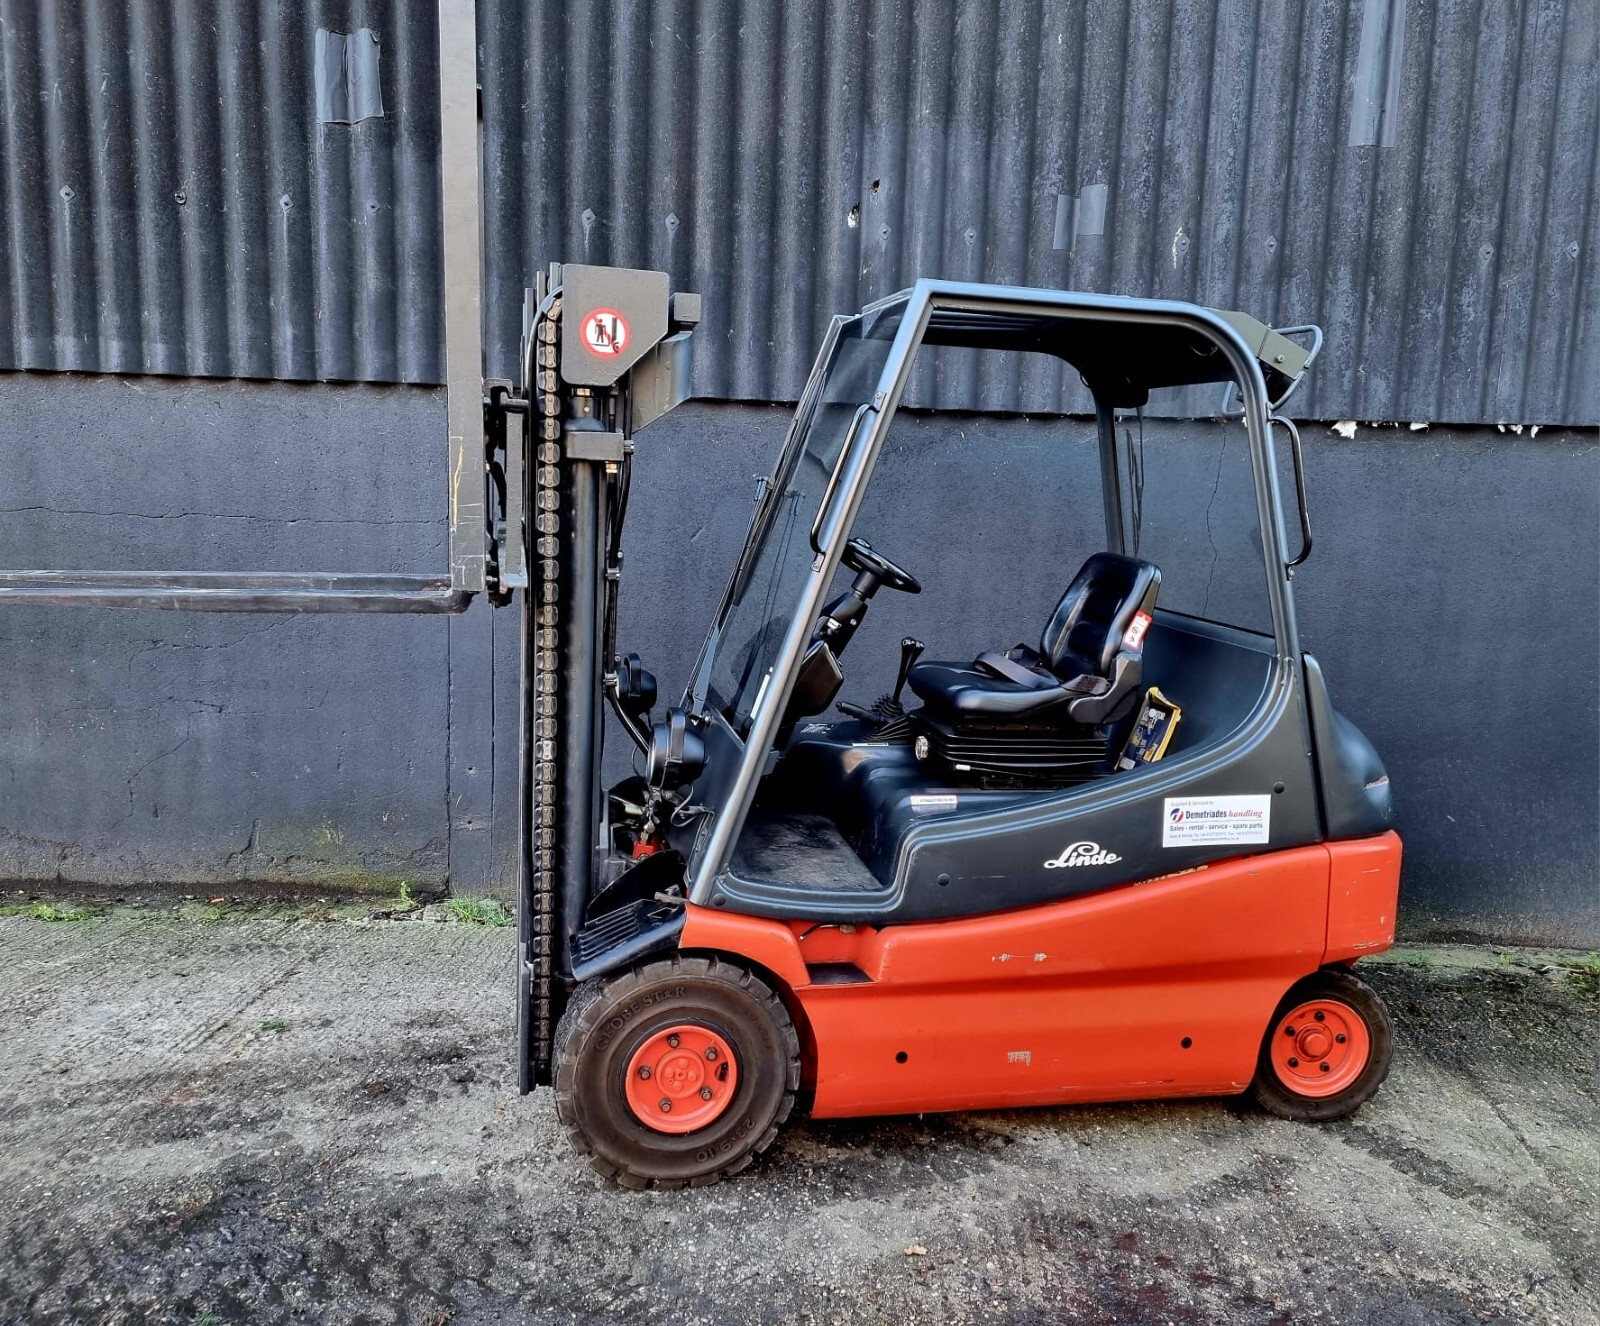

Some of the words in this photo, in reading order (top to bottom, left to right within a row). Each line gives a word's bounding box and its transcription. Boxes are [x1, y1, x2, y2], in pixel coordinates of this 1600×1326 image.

[1185, 809, 1228, 819] Demetriades
[1228, 809, 1263, 819] handling
[1248, 822, 1263, 830] parts
[1043, 841, 1122, 869] Linde
[596, 1003, 641, 1052] GLOBE
